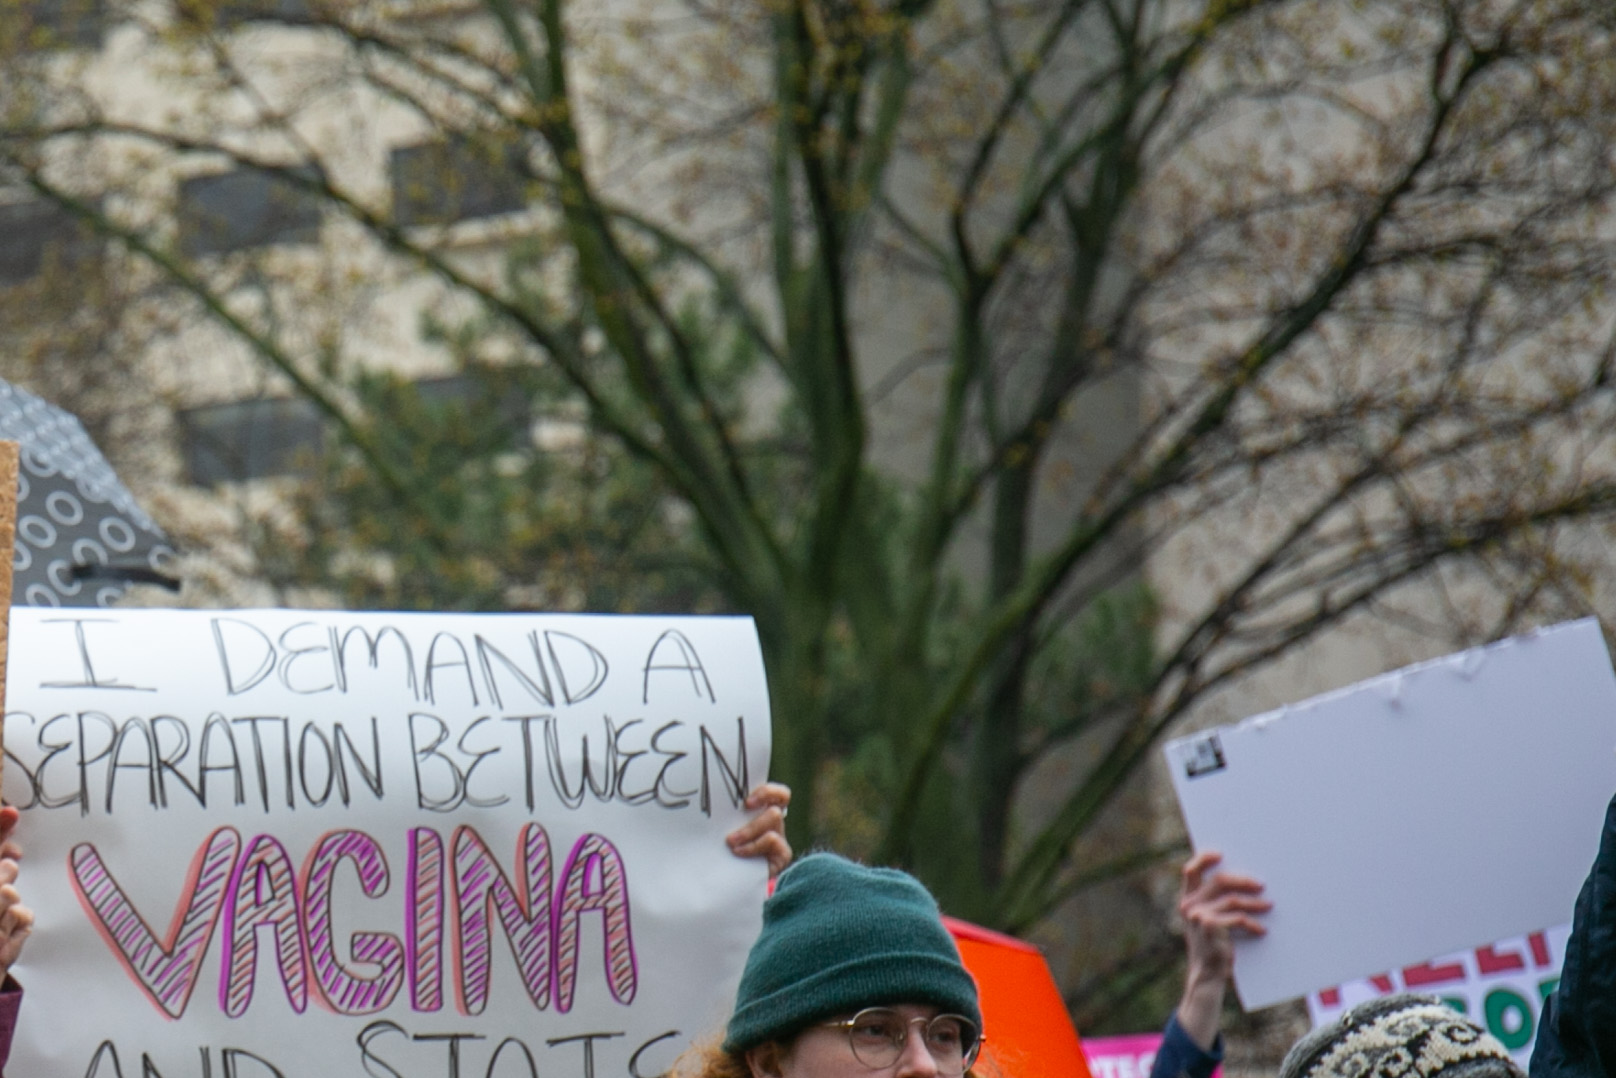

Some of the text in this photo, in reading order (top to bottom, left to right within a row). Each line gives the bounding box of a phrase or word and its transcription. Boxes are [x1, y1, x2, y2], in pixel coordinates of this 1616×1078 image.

[39, 617, 717, 710] I DEMAND A
[1, 711, 749, 818] SEPARATION BETWEEN
[67, 821, 638, 1022] VAGINA
